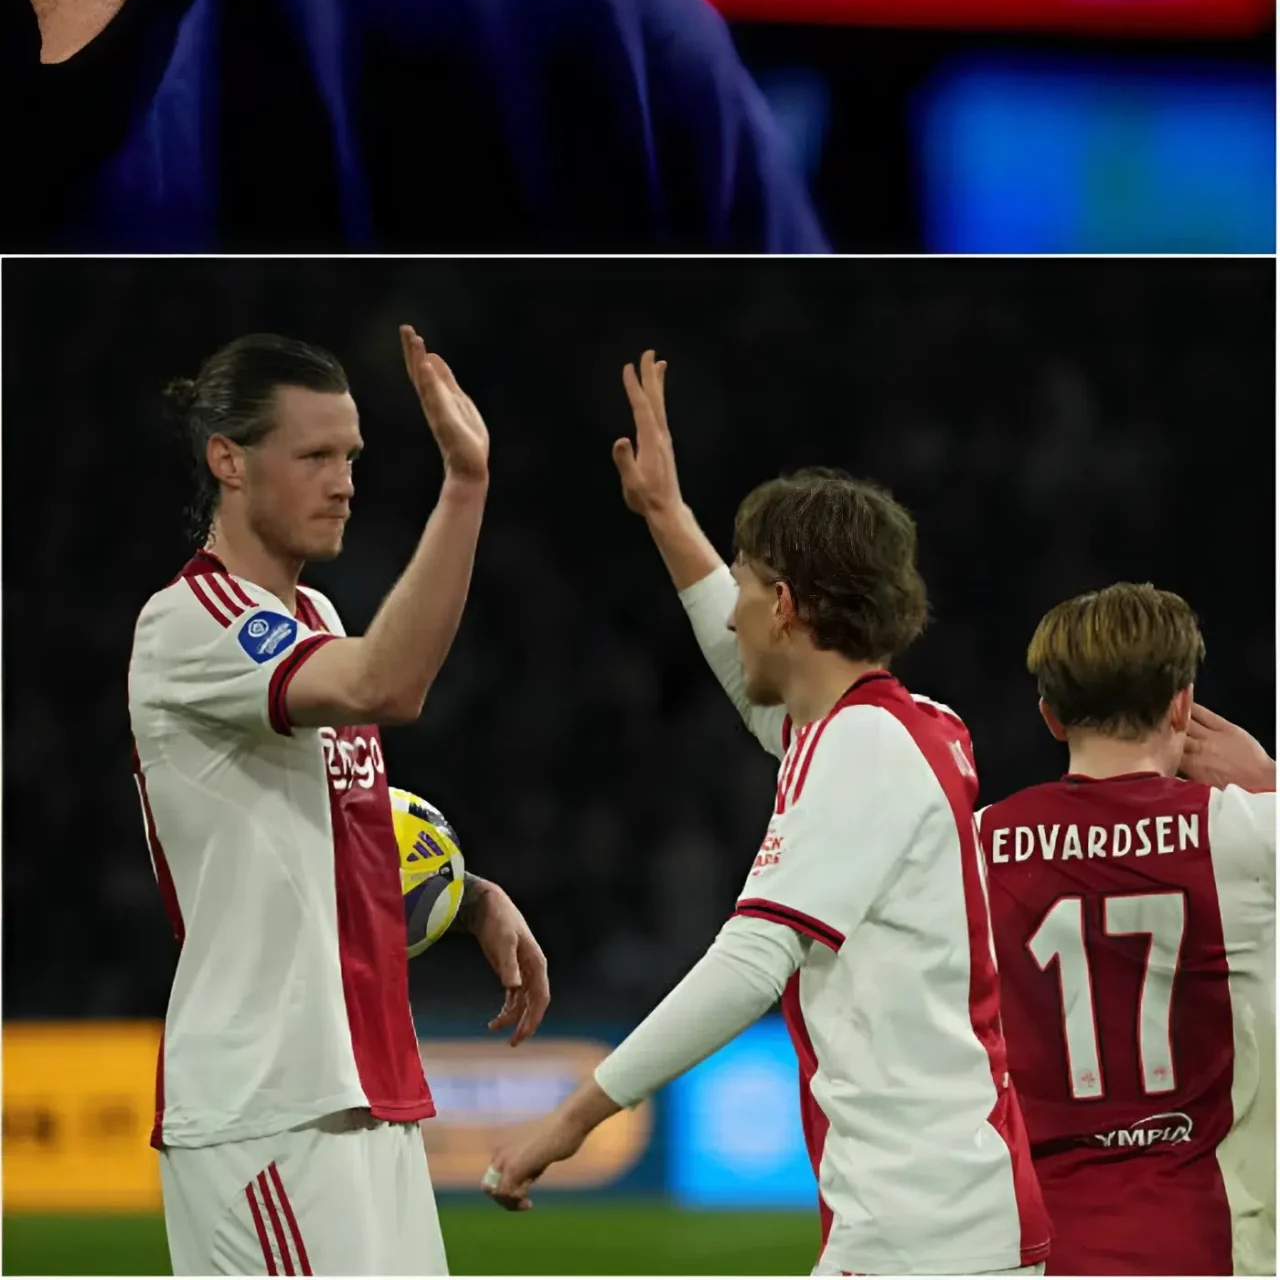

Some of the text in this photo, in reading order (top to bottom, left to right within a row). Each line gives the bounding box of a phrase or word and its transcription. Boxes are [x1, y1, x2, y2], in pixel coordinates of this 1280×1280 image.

[992, 813, 1200, 863] EDVARDSEN
[1025, 892, 1186, 1098] 17
[1095, 1112, 1193, 1147] YMPIA
